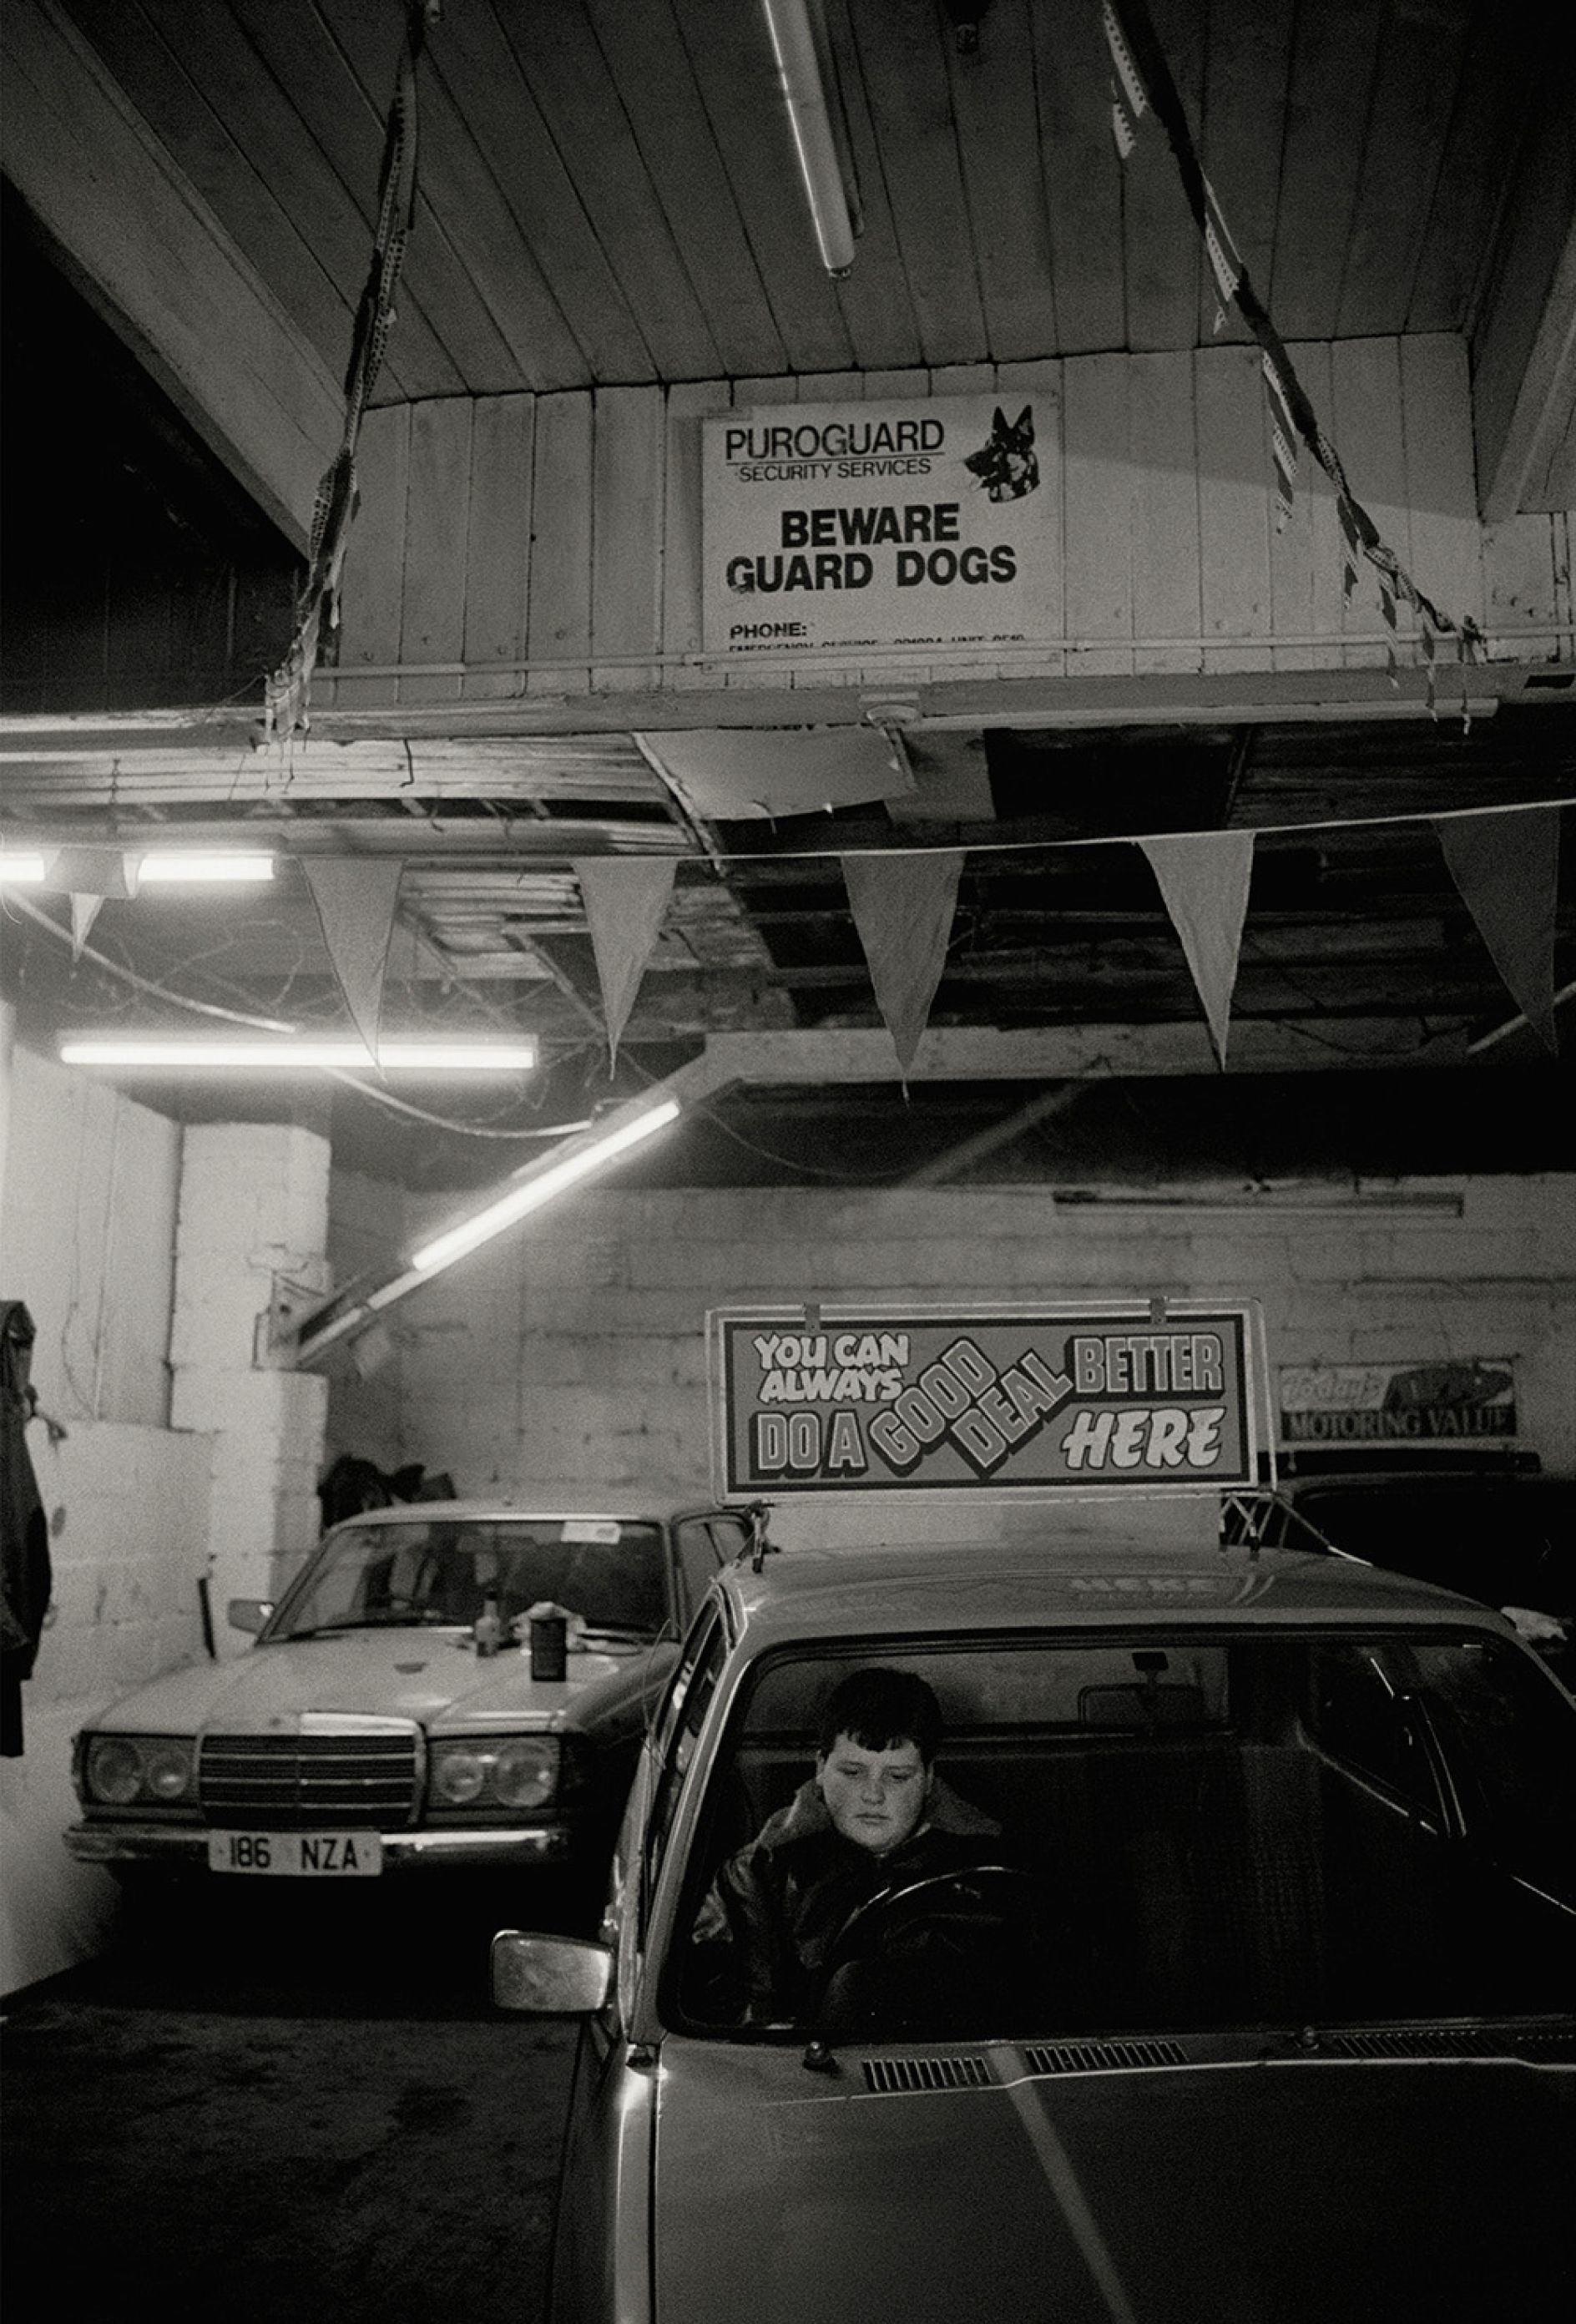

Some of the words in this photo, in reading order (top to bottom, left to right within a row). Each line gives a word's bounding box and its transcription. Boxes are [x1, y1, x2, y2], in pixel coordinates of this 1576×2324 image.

[725, 419, 945, 460] PUROGUARD
[739, 463, 833, 482] SECURITY
[837, 458, 932, 478] SERVICES
[781, 503, 960, 548] BEWARE
[726, 552, 874, 594] GUARD
[897, 544, 1017, 587] DOGS
[730, 622, 807, 639] PHONE:
[752, 1332, 830, 1369] YOU
[833, 1333, 909, 1368] CAN
[1068, 1334, 1225, 1397] BETTER
[759, 1367, 904, 1403] ALWAYS
[869, 1336, 998, 1471] GOOD
[950, 1351, 1074, 1473] DEAL
[1289, 1411, 1422, 1438] MOTORING
[1428, 1404, 1505, 1435] VALUE
[754, 1411, 822, 1476] DO
[825, 1411, 866, 1474] A
[1061, 1407, 1227, 1473] HERE
[230, 1836, 270, 1868] 186
[301, 1838, 358, 1870] NZA
